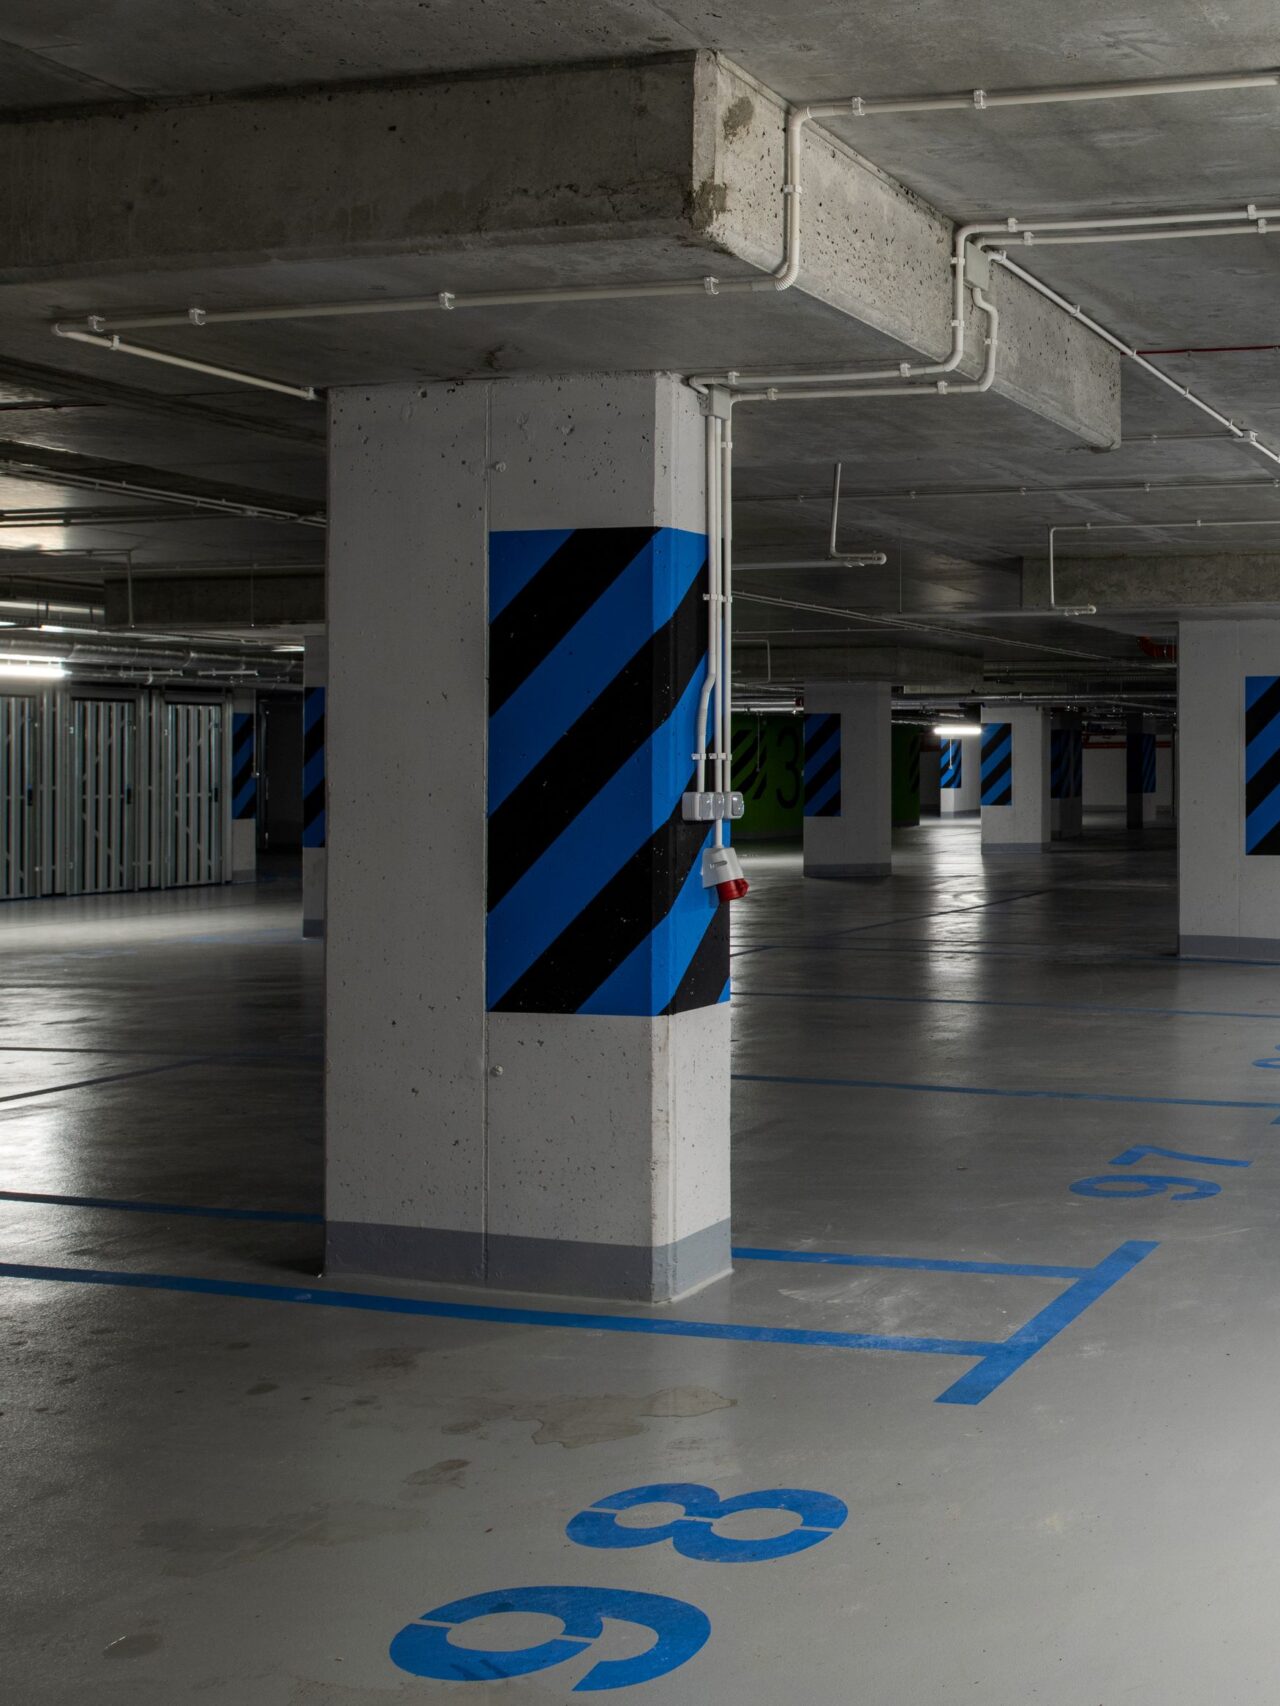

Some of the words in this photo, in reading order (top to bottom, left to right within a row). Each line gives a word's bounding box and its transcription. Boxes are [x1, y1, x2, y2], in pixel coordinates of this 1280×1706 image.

[776, 726, 801, 810] 3
[1069, 1145, 1254, 1201] 97
[388, 1482, 849, 1693] 98
